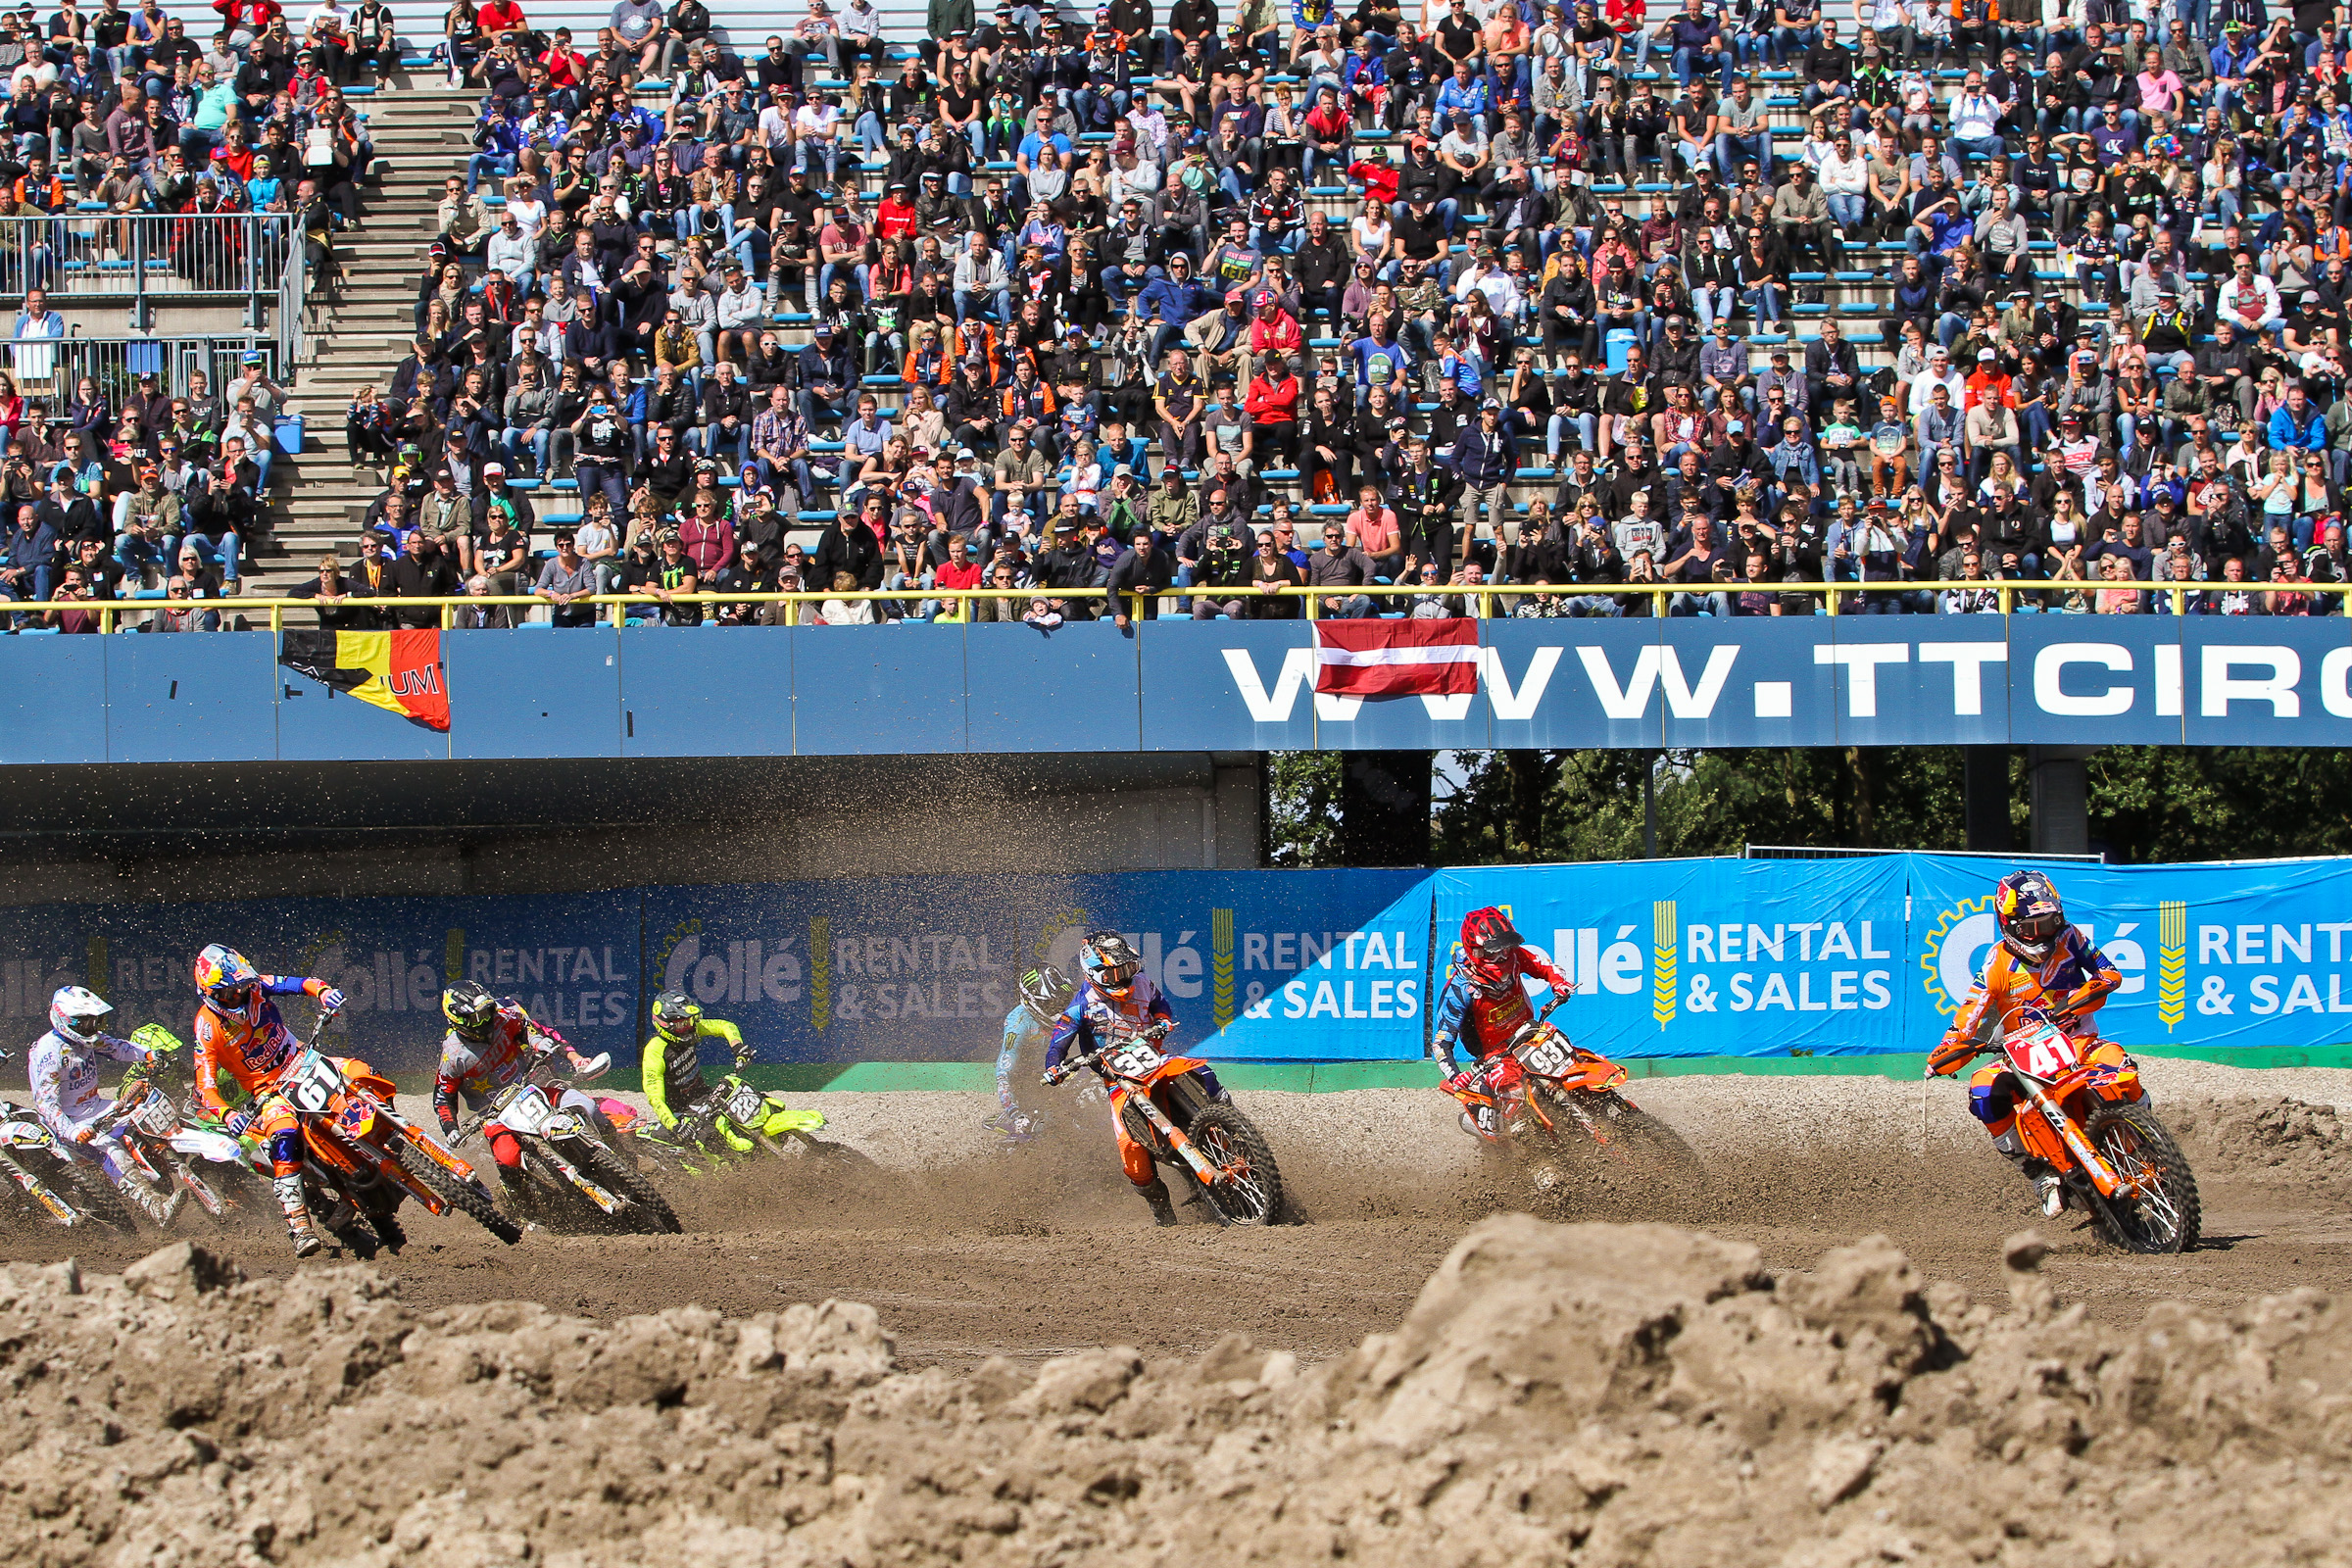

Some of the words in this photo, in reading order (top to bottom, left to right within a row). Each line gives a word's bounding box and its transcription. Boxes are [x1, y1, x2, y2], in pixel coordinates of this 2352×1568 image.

[836, 934, 1001, 973] RENTAL
[1244, 932, 1418, 971] RENTAL
[1688, 921, 1890, 963] RENTAL
[2199, 923, 2352, 963] RENT
[471, 947, 628, 984] RENTAL
[836, 982, 867, 1020] &
[875, 981, 1005, 1020] SALES
[1244, 981, 1273, 1020] &
[1283, 979, 1419, 1020] SALES
[1686, 976, 1719, 1012] &
[1730, 969, 1891, 1012] SALES
[2196, 978, 2235, 1015] &
[2250, 973, 2352, 1015] SAL
[245, 1043, 274, 1071] Red
[269, 1022, 285, 1054] Bull
[1115, 1045, 1161, 1077] 33
[1530, 1032, 1574, 1076] 931
[1932, 1046, 1949, 1058] KTM
[2029, 1034, 2074, 1077] 41
[297, 1055, 341, 1112] 61
